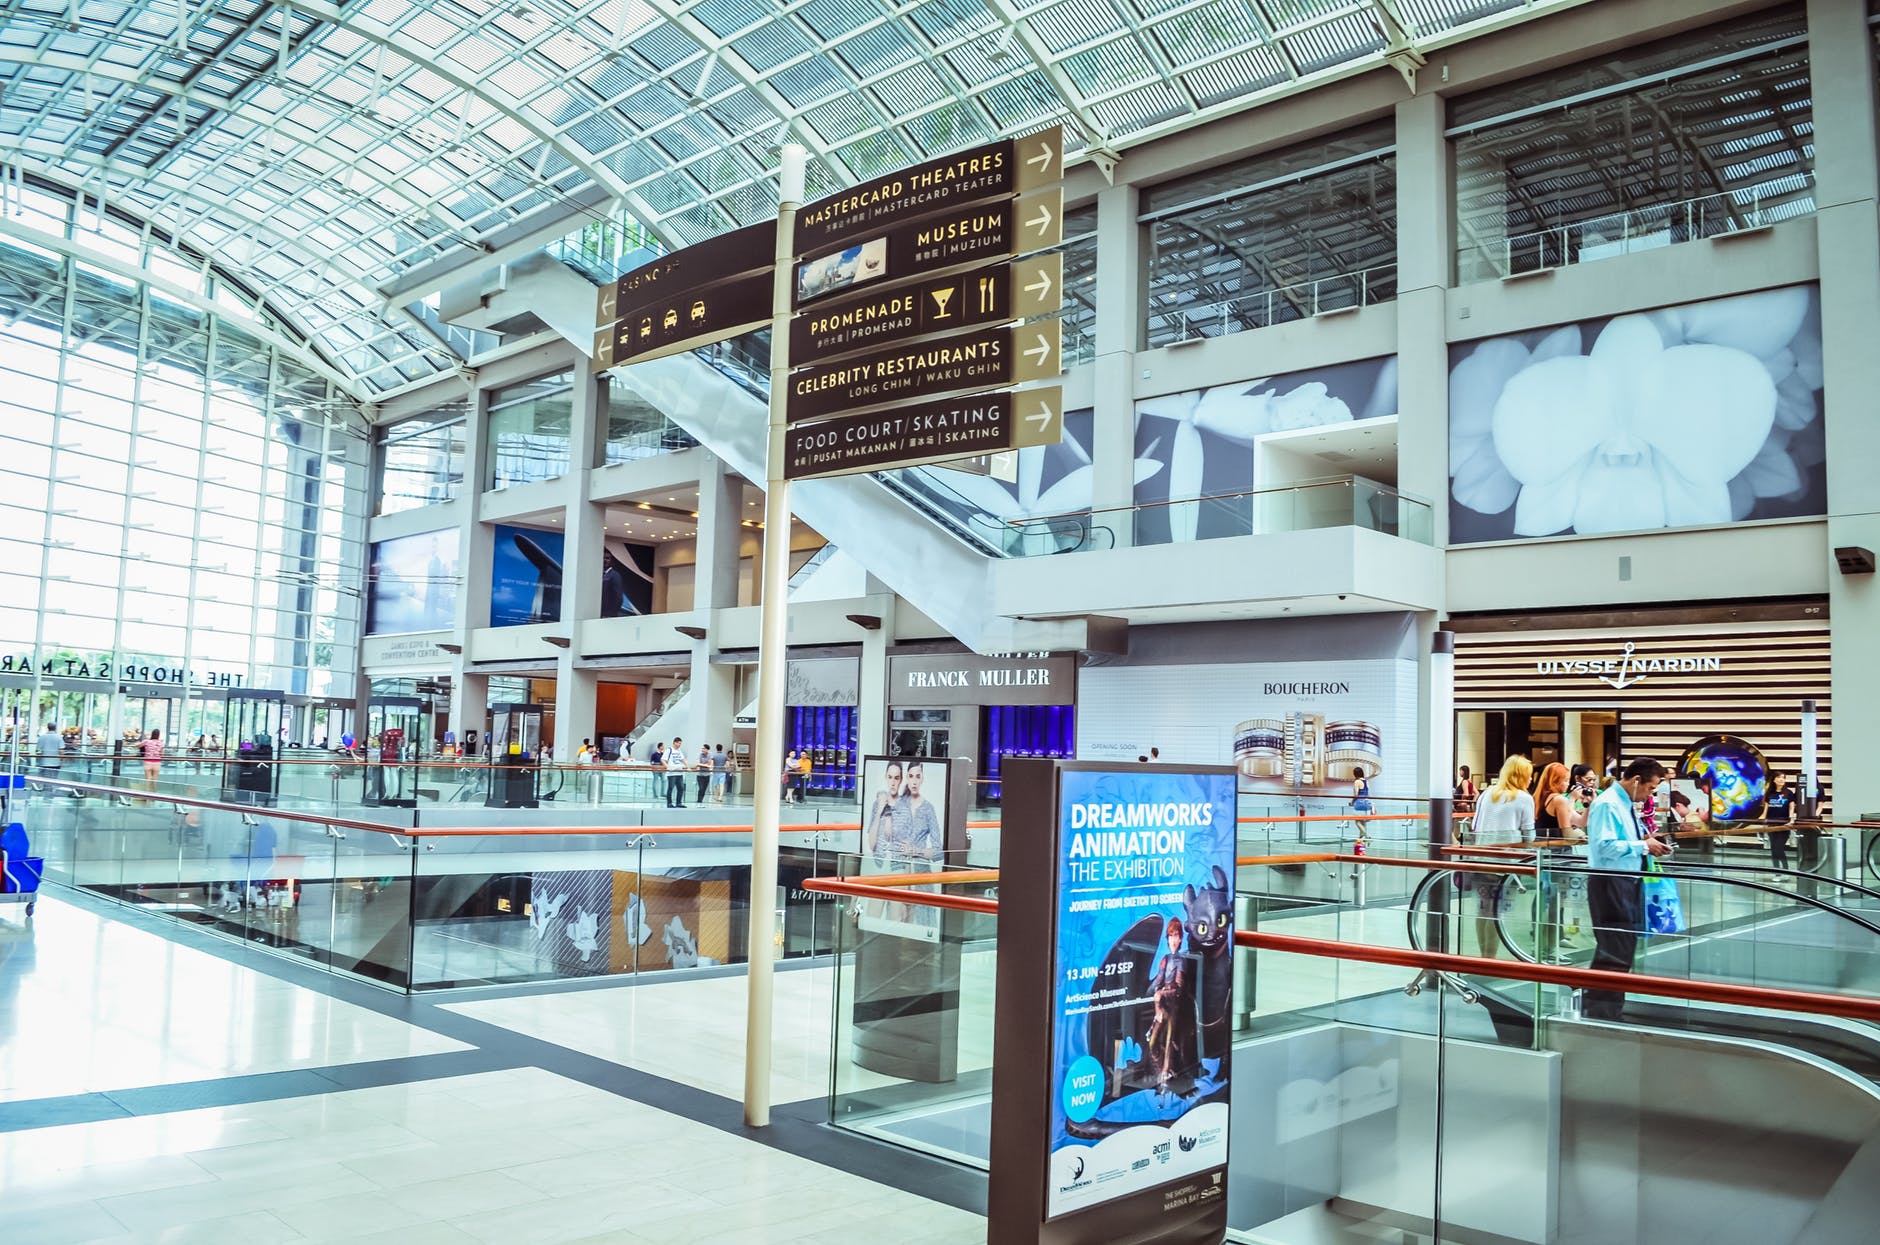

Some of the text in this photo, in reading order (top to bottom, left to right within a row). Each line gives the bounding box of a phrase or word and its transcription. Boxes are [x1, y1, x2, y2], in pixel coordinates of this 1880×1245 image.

[804, 152, 1003, 228] MASTERCARD THEATRES
[874, 173, 1002, 217] MASTERCARD TEATER
[917, 214, 1002, 247] MUSEUM
[950, 234, 1001, 255] MUZIUM
[811, 296, 914, 336] PROMENADE
[852, 317, 912, 340] PROMENAD
[797, 341, 1000, 396] CELEBRITY RESTAURANTS
[849, 383, 878, 399] LONG
[883, 377, 912, 391] CHIM
[926, 367, 961, 383] WAKU
[968, 361, 1001, 376] GHIN
[796, 431, 838, 451] FOOD
[945, 426, 1000, 443] SKATING
[813, 449, 843, 465] PUSAT
[846, 440, 897, 458] MAKANAN
[1537, 656, 1720, 675] ULYSSE NARDIN
[908, 668, 1050, 688] FRANCK MULLER
[1263, 681, 1350, 695] BOUCHERON
[1071, 802, 1213, 829] DREAMWORKS
[1069, 830, 1185, 859] ANIMATION
[1069, 857, 1185, 882] THE EXHIBITION
[1069, 899, 1102, 912] JOURNEY
[1066, 968, 1078, 981] 13
[1079, 966, 1099, 979] JUN
[1105, 963, 1117, 976] 27
[1117, 961, 1134, 974] SEP
[1072, 1073, 1097, 1089] VISIT
[1071, 1091, 1097, 1107] NOW
[1152, 1139, 1171, 1155] acmi
[1163, 1197, 1188, 1211] MARINA
